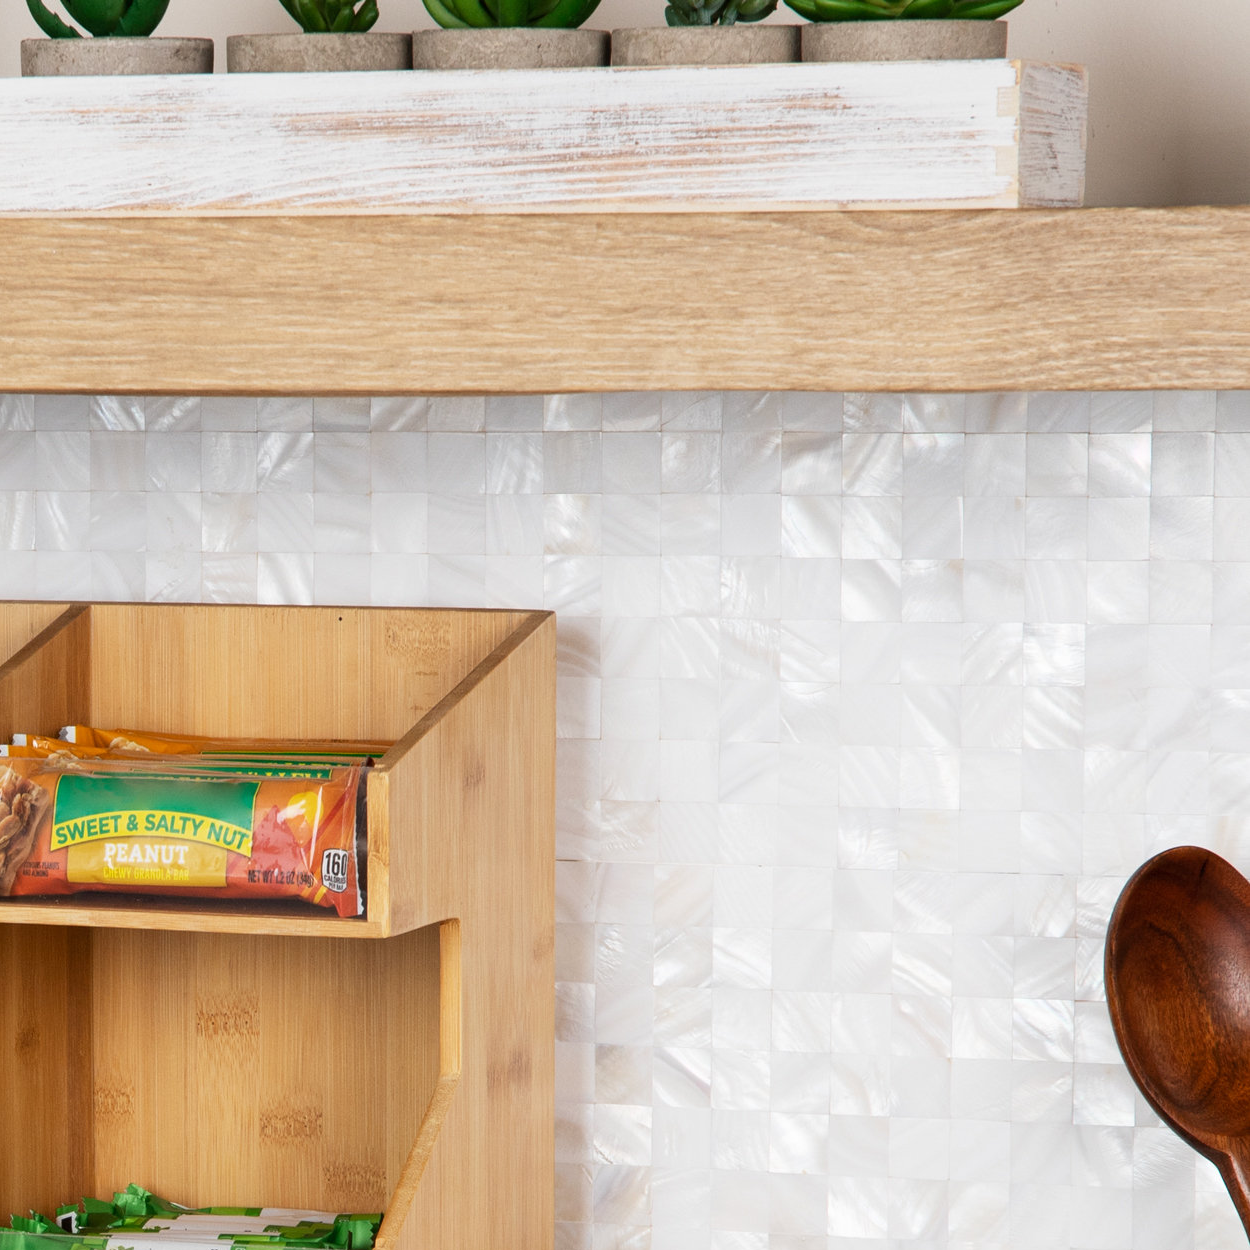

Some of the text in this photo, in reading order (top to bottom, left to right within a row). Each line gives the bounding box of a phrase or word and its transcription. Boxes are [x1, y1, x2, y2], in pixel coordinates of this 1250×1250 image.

[55, 814, 249, 850] SWEET & SALTY NUT
[103, 843, 189, 865] PEANUT
[325, 852, 347, 876] 160
[103, 867, 189, 881] CHEWY GRANOLA BAR
[248, 869, 261, 883] NET
[263, 870, 273, 883] WT
[286, 871, 295, 884] OZ
[324, 875, 346, 884] CALORIES
